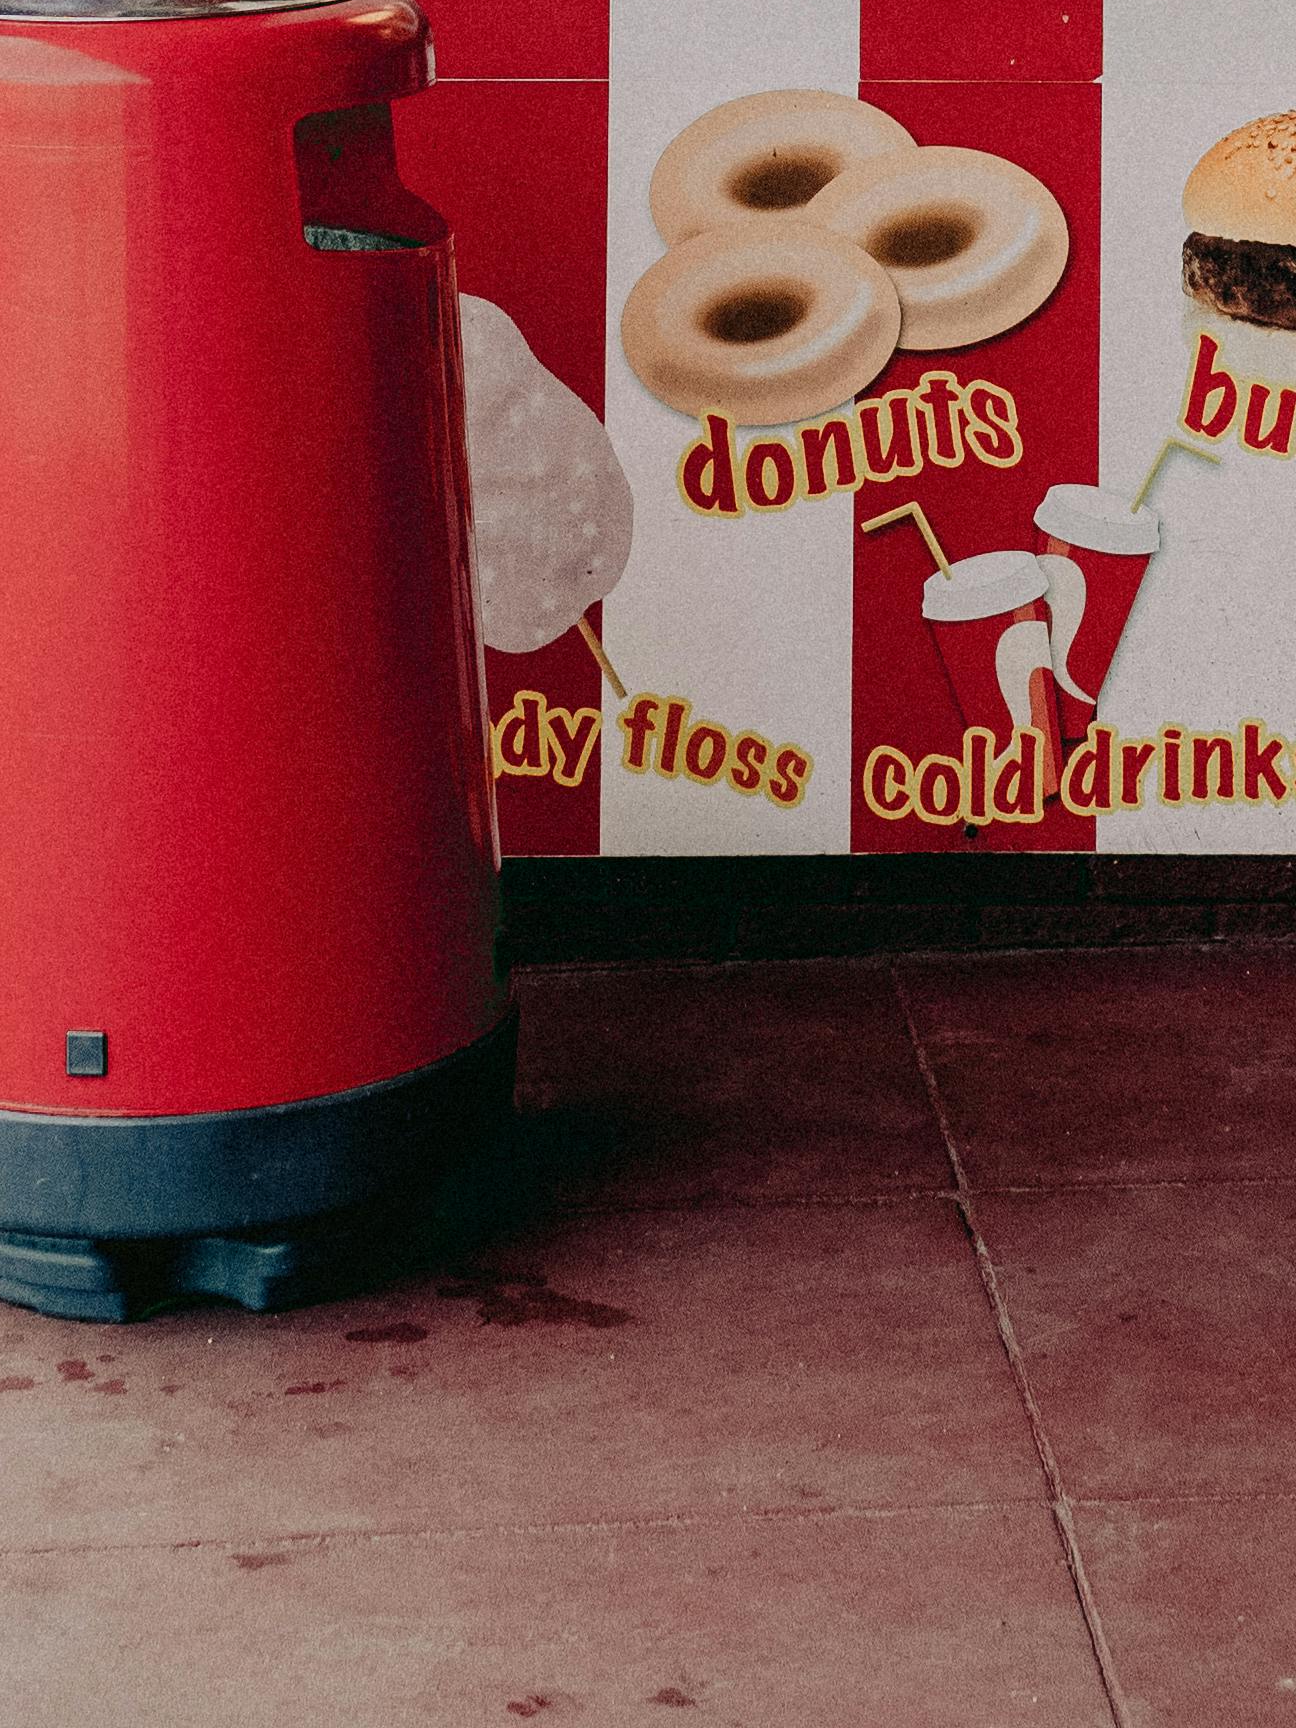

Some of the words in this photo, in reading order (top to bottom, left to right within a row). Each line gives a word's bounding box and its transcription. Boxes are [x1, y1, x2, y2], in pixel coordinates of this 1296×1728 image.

[678, 370, 1024, 518] donuts
[493, 690, 601, 788] dy
[616, 693, 814, 811] floss
[862, 725, 1047, 826] cold
